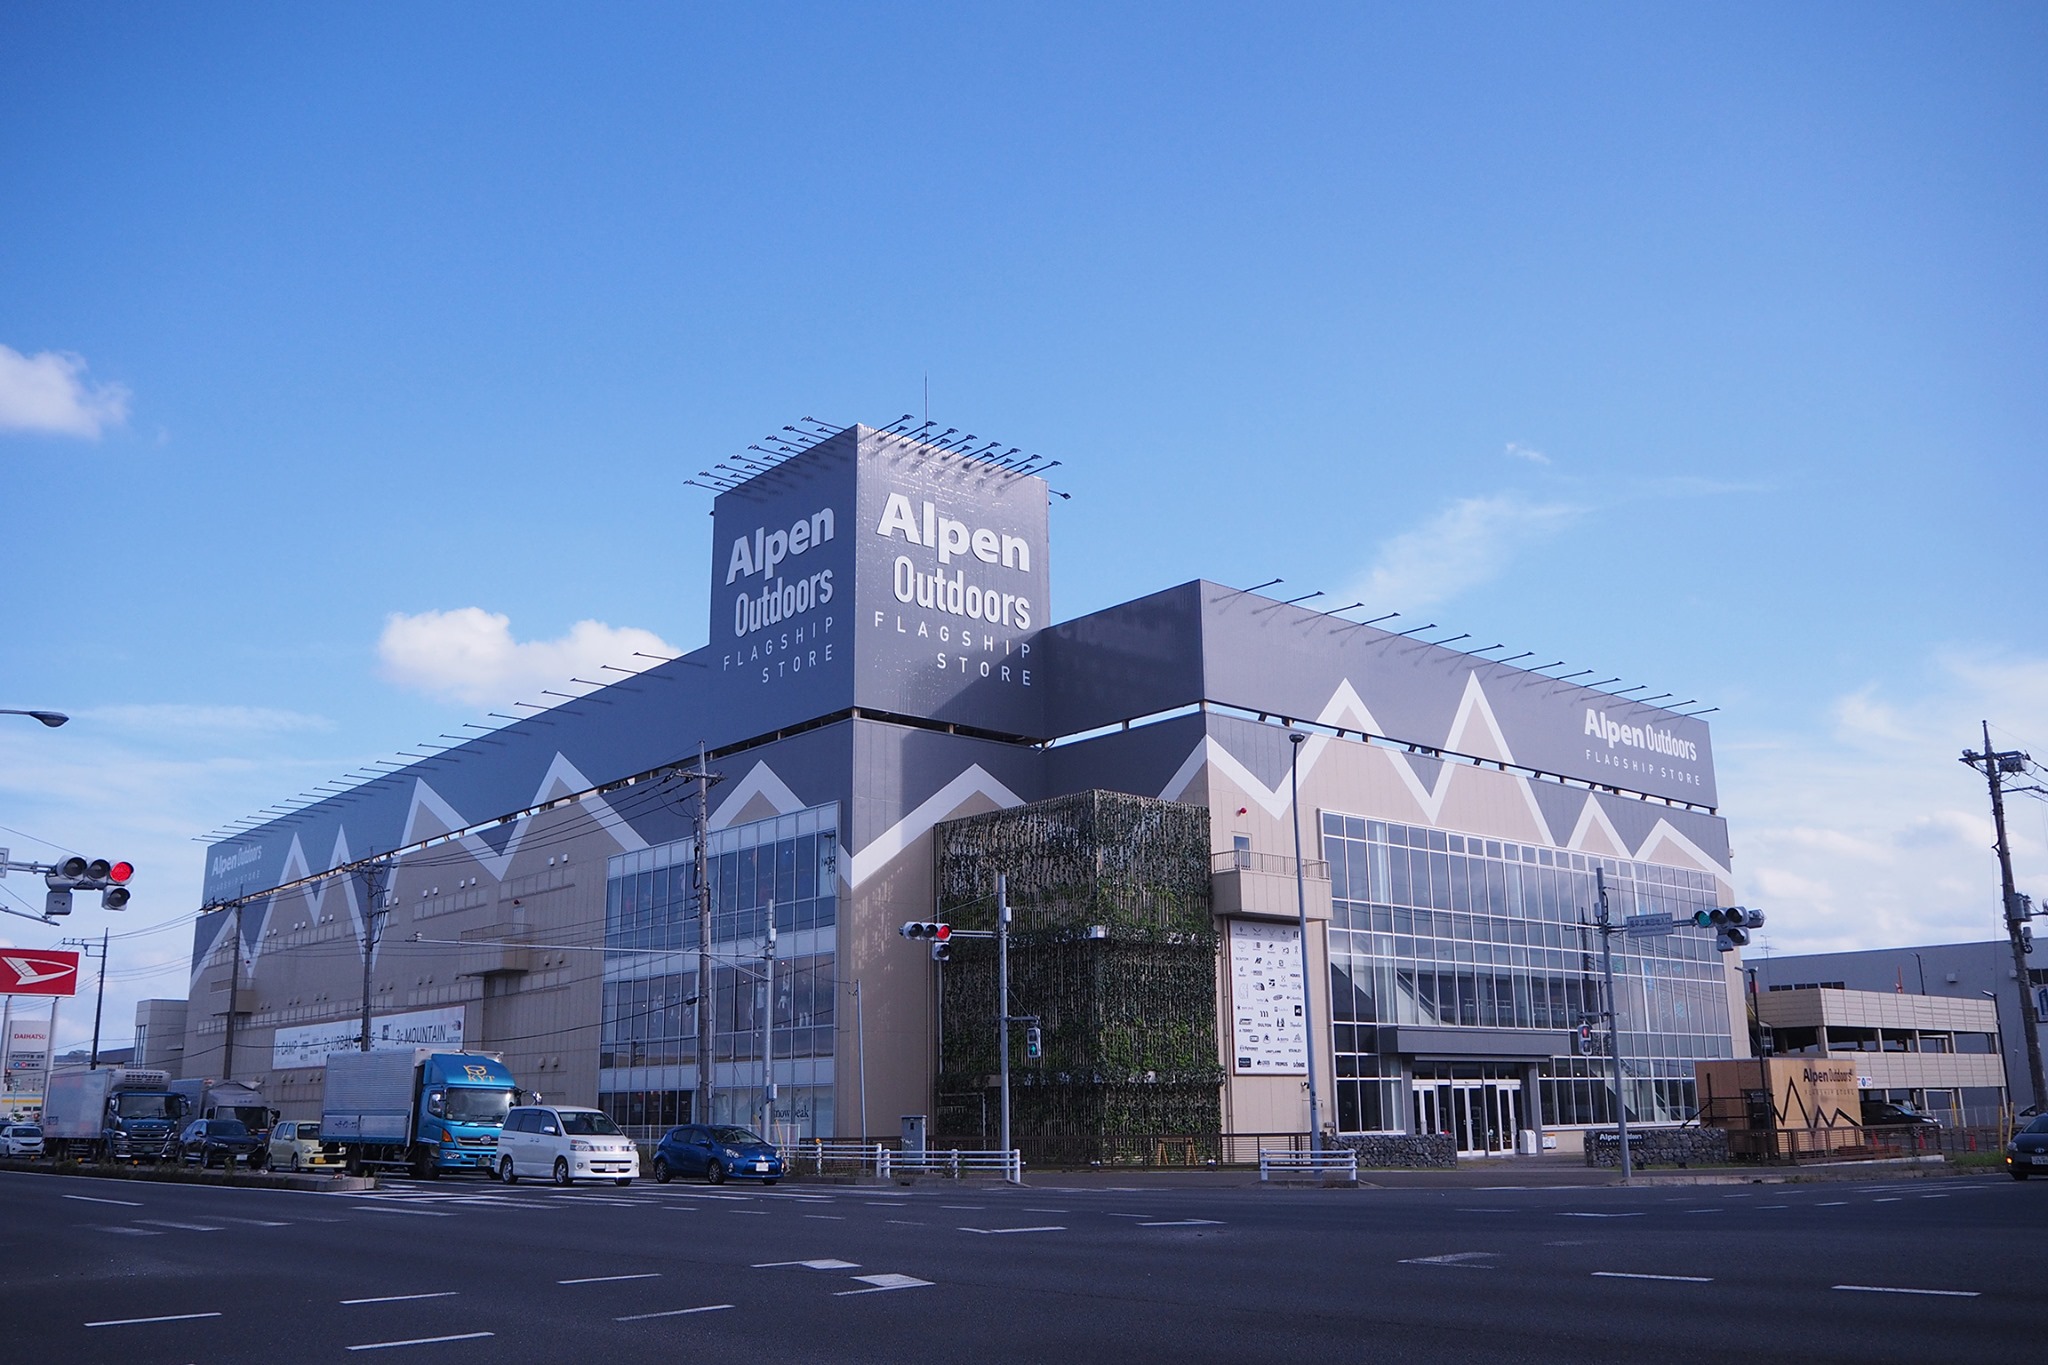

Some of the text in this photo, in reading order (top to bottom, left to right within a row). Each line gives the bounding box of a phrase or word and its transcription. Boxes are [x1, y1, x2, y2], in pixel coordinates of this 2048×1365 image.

[725, 507, 835, 586] Alpen
[876, 492, 1031, 573] Alpen
[734, 569, 834, 638] Outdoors
[894, 555, 1031, 631] Outdoors
[723, 616, 834, 672] FLAGSHIP
[874, 611, 1031, 659] FLAGSHIP
[762, 644, 833, 683] STORE
[937, 653, 1031, 686] STORE
[1584, 708, 1697, 762] Alpen Outdoors
[1586, 750, 1700, 786] FLAGSHIP STORE
[211, 854, 238, 879] Alpen
[405, 1024, 447, 1045] MOUNTAIN
[1803, 1068, 1829, 1086] Alpen
